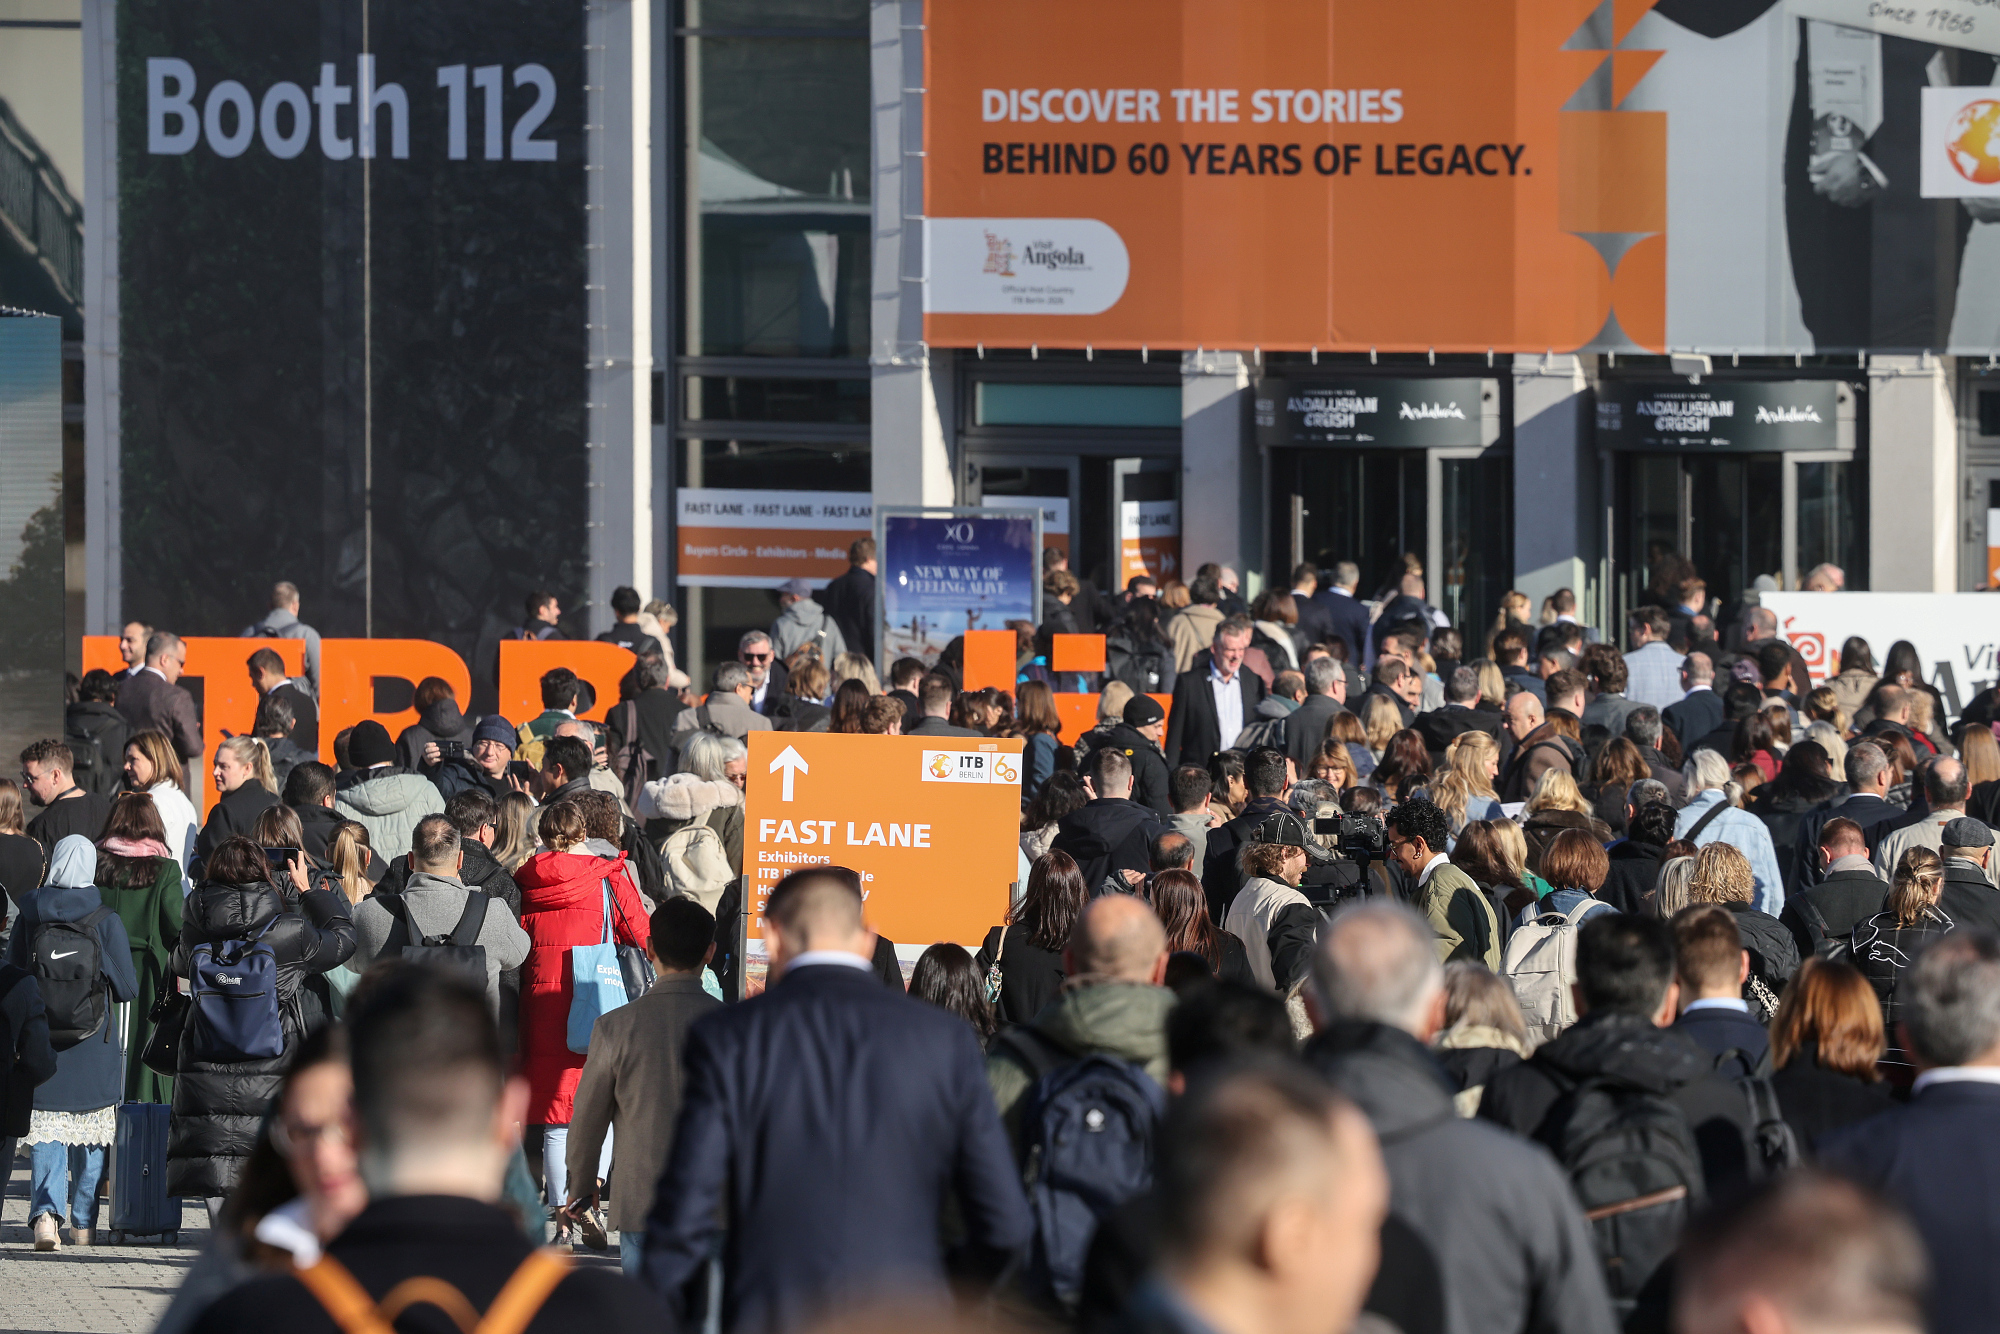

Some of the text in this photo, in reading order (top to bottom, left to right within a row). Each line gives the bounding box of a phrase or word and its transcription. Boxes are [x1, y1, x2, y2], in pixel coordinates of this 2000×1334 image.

[1926, 8, 1976, 34] 1966
[147, 54, 557, 161] Booth 112
[982, 89, 1404, 123] DISCOVER THE STORIES
[983, 143, 1532, 176] BEHIND 60 YEARS OF LEGACY.
[1022, 245, 1085, 270] Angola
[685, 503, 711, 515] FAST
[714, 504, 743, 515] LANE
[754, 504, 780, 516] FAST
[783, 505, 812, 517] LANE
[823, 505, 849, 517] FAST
[852, 506, 872, 518] LAN
[944, 522, 974, 544] XO
[684, 544, 719, 558] Buyers
[914, 565, 1003, 580] NEW WAY OF
[967, 581, 1008, 595] ALIVE
[960, 756, 984, 768] ITB
[959, 771, 984, 779] BERLIN
[759, 819, 931, 848] FAST LANE
[758, 851, 831, 865] Exhibitors
[758, 868, 780, 879] ITB
